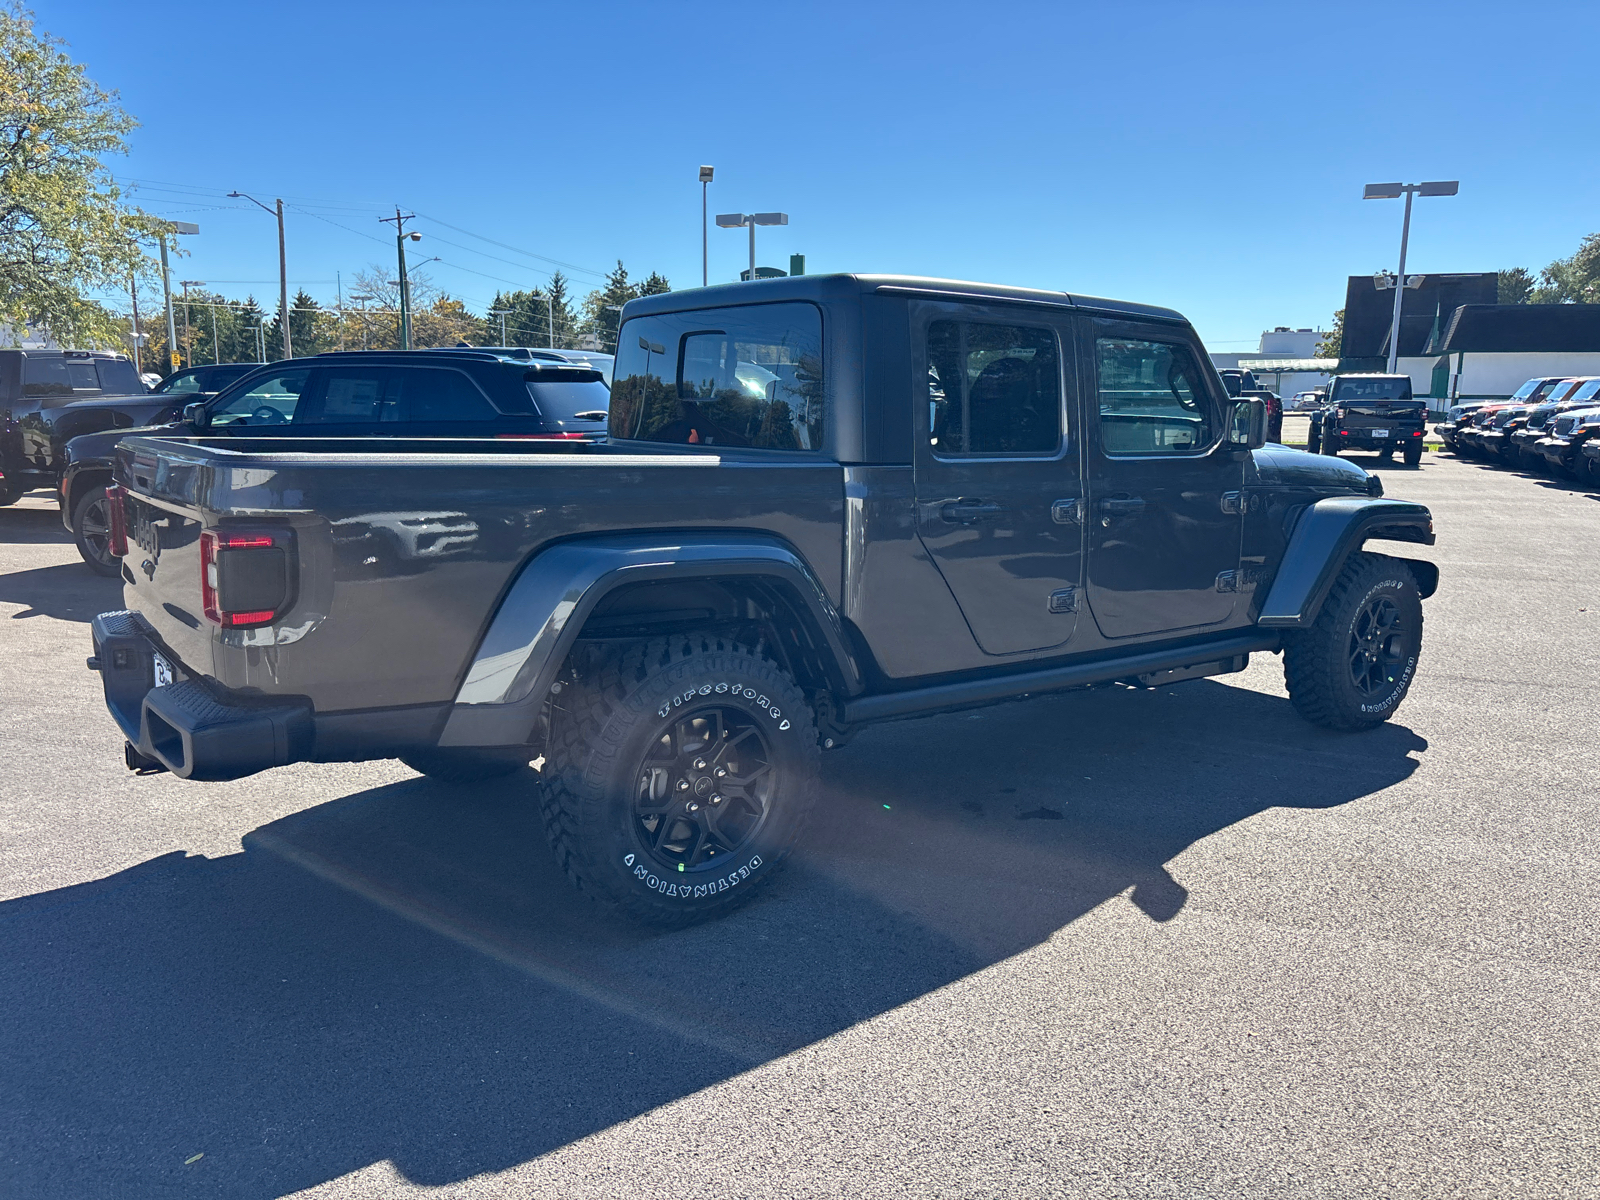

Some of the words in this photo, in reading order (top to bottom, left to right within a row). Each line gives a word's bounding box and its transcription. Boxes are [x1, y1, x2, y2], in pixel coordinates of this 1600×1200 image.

[658, 682, 781, 718] Firestone
[1366, 656, 1415, 713] DESTINATION
[633, 854, 763, 898] DESTINATION
